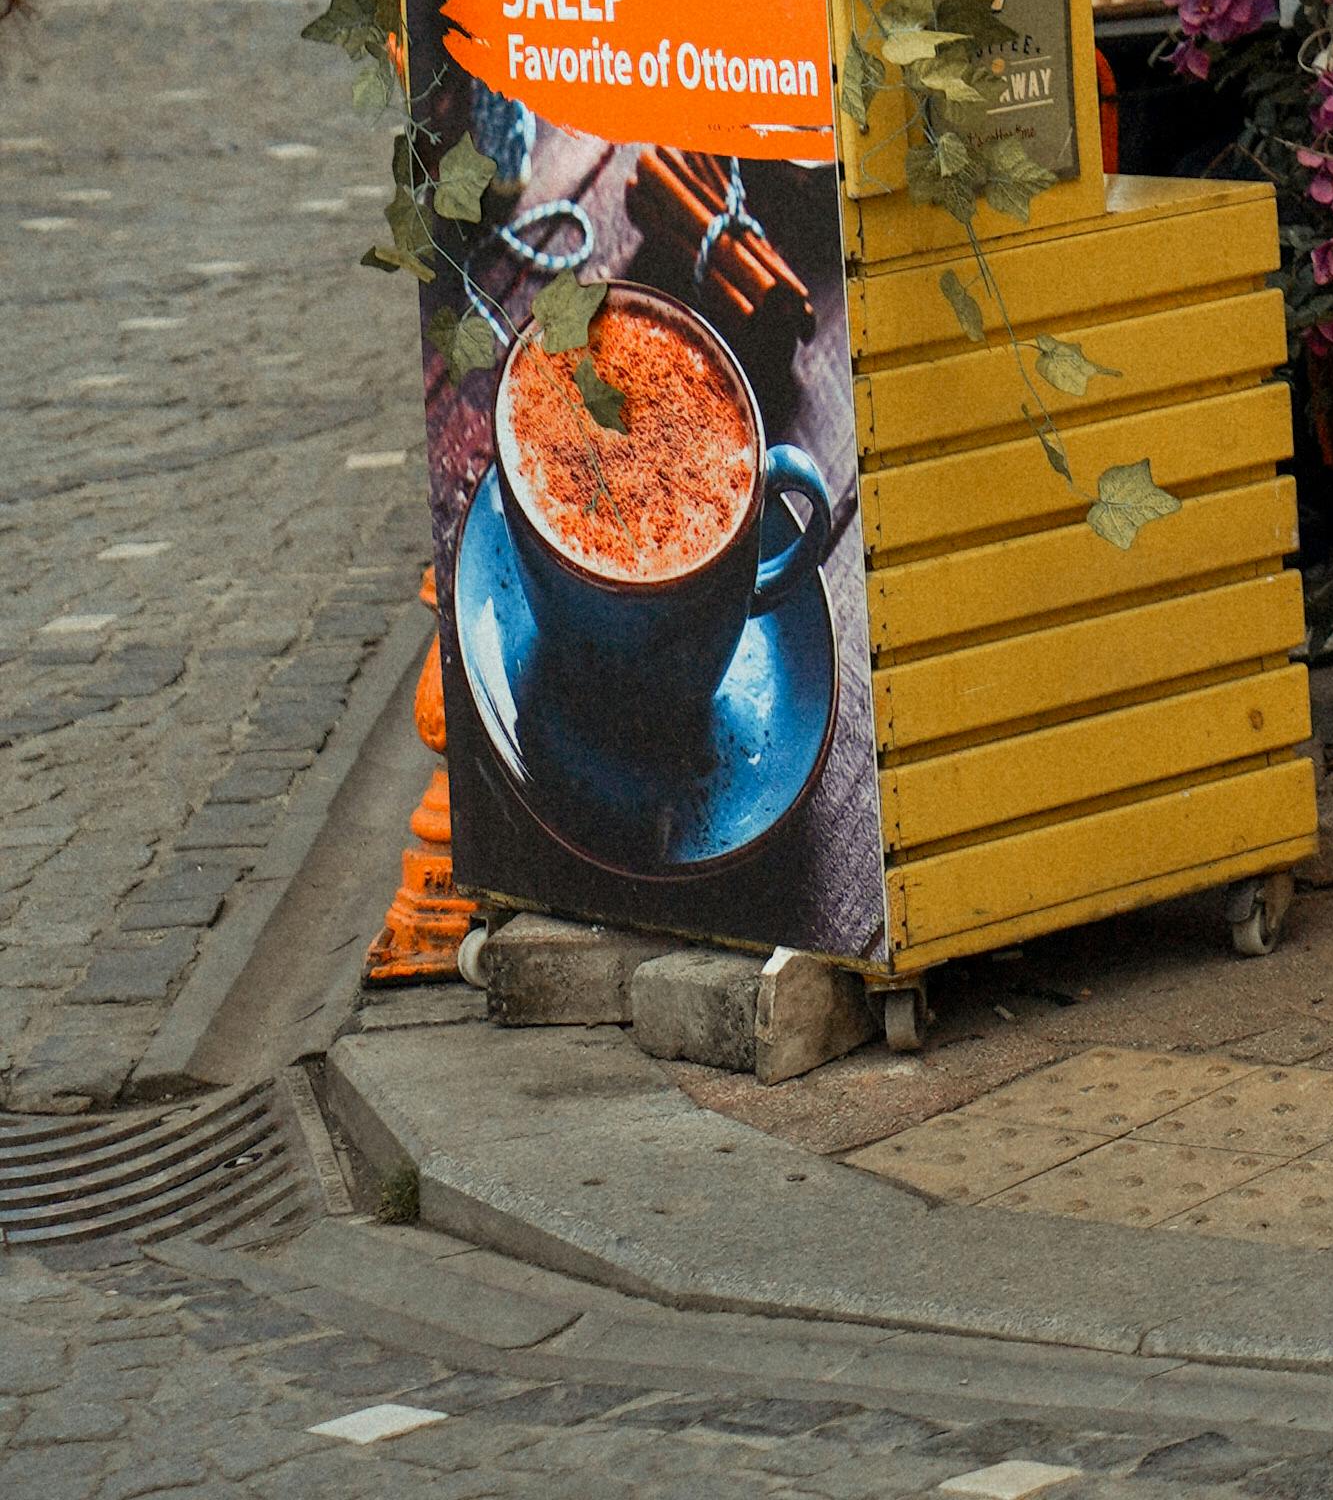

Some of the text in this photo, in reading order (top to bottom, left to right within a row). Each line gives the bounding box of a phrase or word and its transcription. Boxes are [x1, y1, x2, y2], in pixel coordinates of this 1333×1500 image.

[507, 32, 819, 98] Favorite of Ottoman
